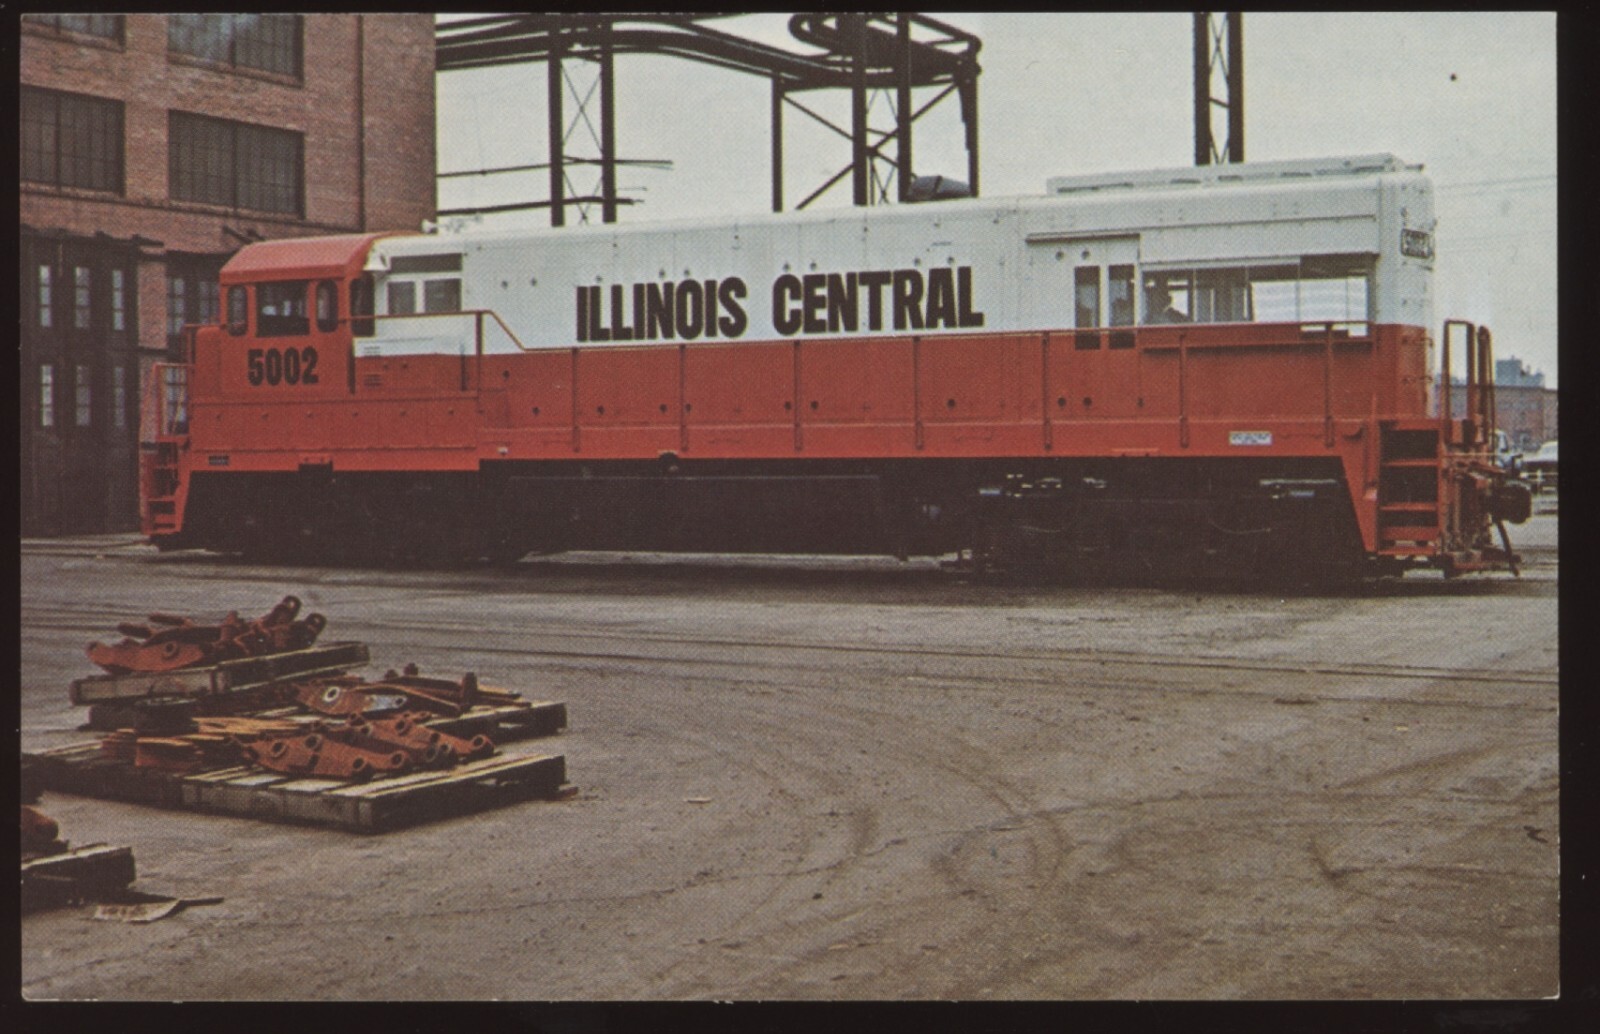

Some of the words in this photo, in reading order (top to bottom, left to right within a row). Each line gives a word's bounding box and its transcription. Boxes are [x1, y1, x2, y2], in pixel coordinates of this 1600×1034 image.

[576, 276, 748, 342] ILLINOIS
[772, 266, 985, 336] CENTRAL
[247, 346, 319, 387] 5002
